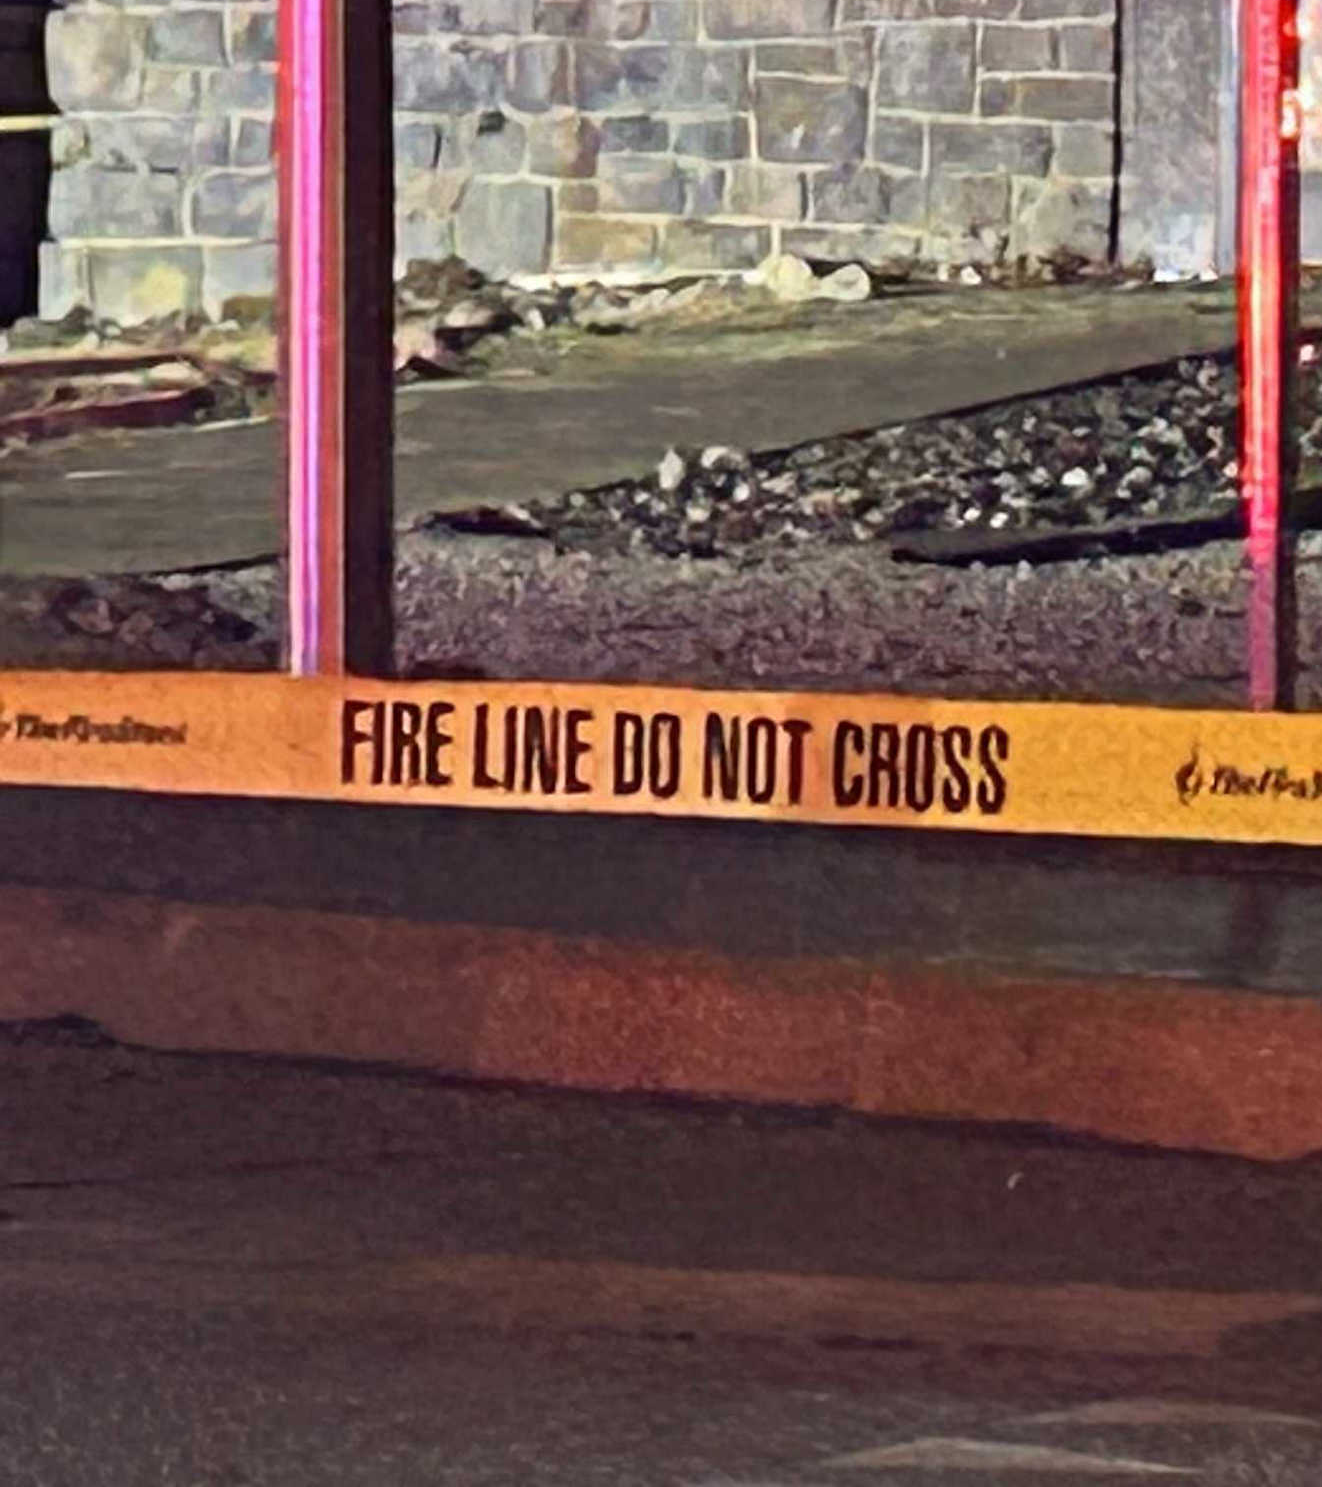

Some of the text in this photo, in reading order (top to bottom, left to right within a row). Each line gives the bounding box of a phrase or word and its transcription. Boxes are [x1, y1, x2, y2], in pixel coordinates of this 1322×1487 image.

[341, 699, 1009, 814] FIRE LINE DO NOT CROSS
